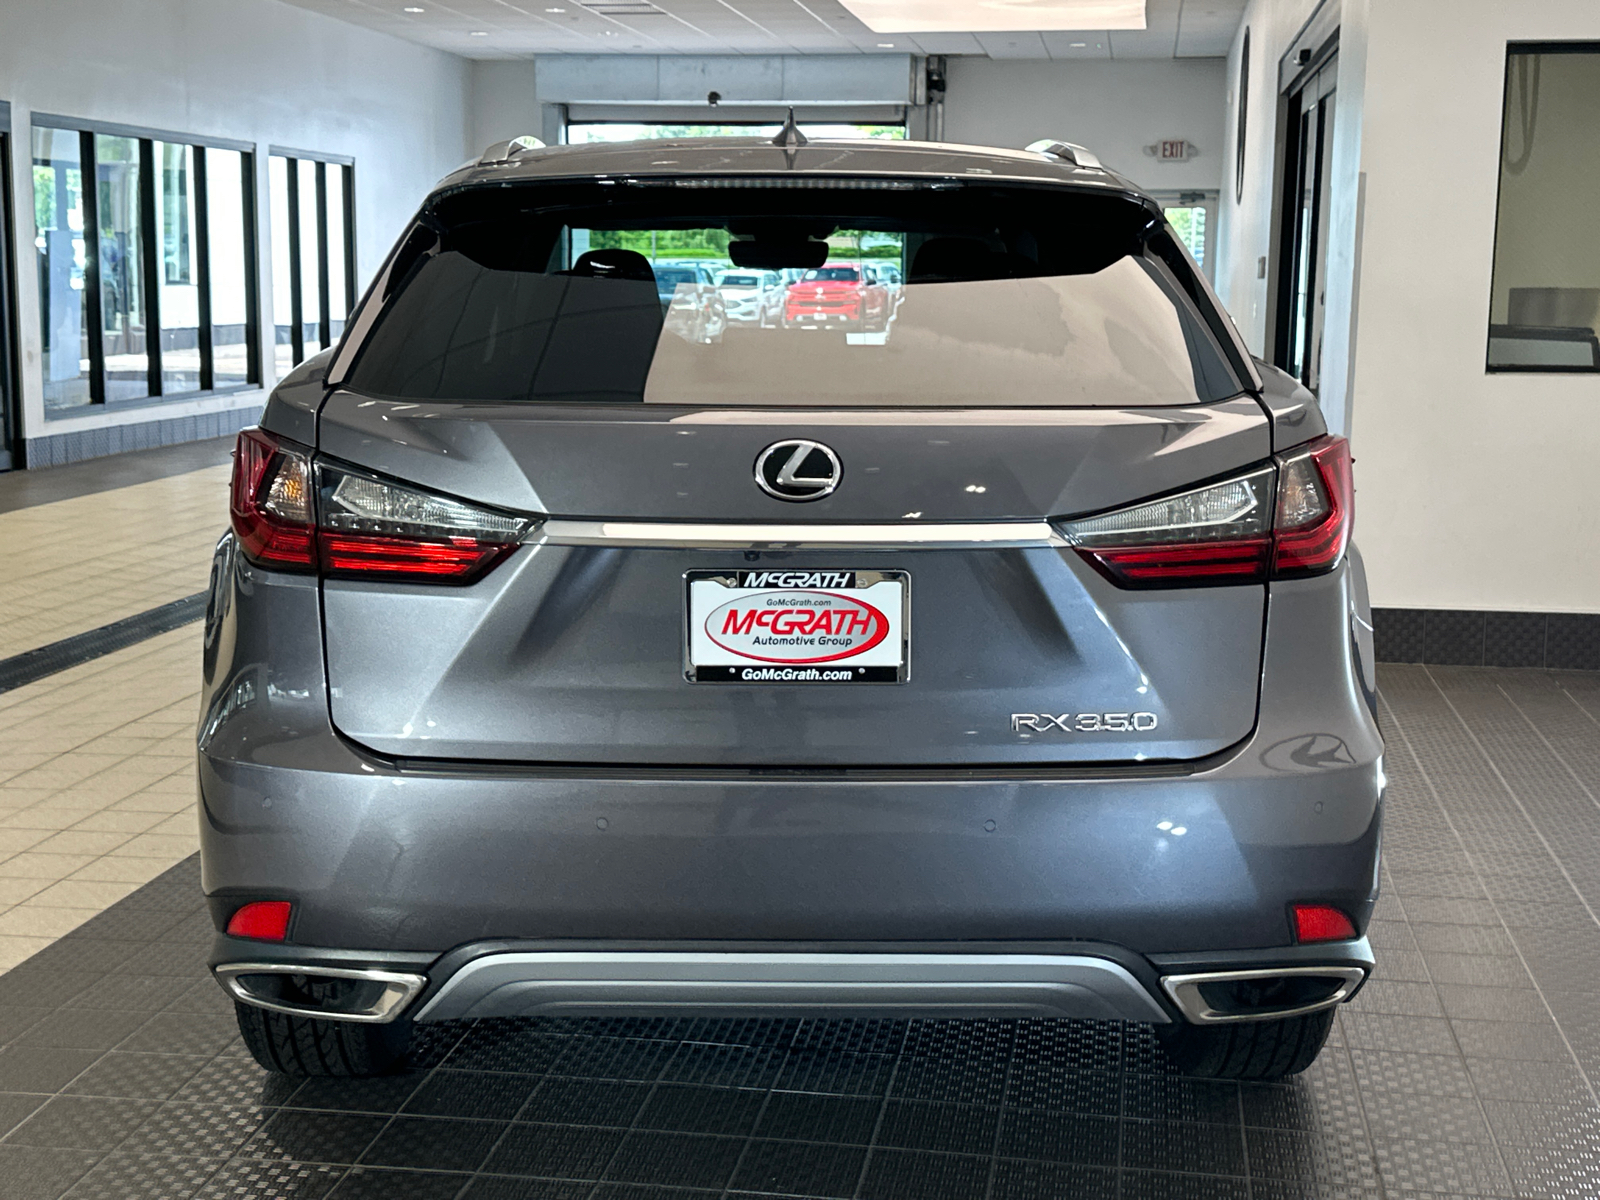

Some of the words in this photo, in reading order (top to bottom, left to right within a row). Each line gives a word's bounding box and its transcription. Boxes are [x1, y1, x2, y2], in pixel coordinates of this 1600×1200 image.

[1162, 140, 1184, 158] EXIT
[766, 598, 832, 608] GoMcGrath.com
[752, 636, 816, 646] Automotive
[818, 636, 853, 648] Group
[741, 668, 852, 681] GoMcGrath.com
